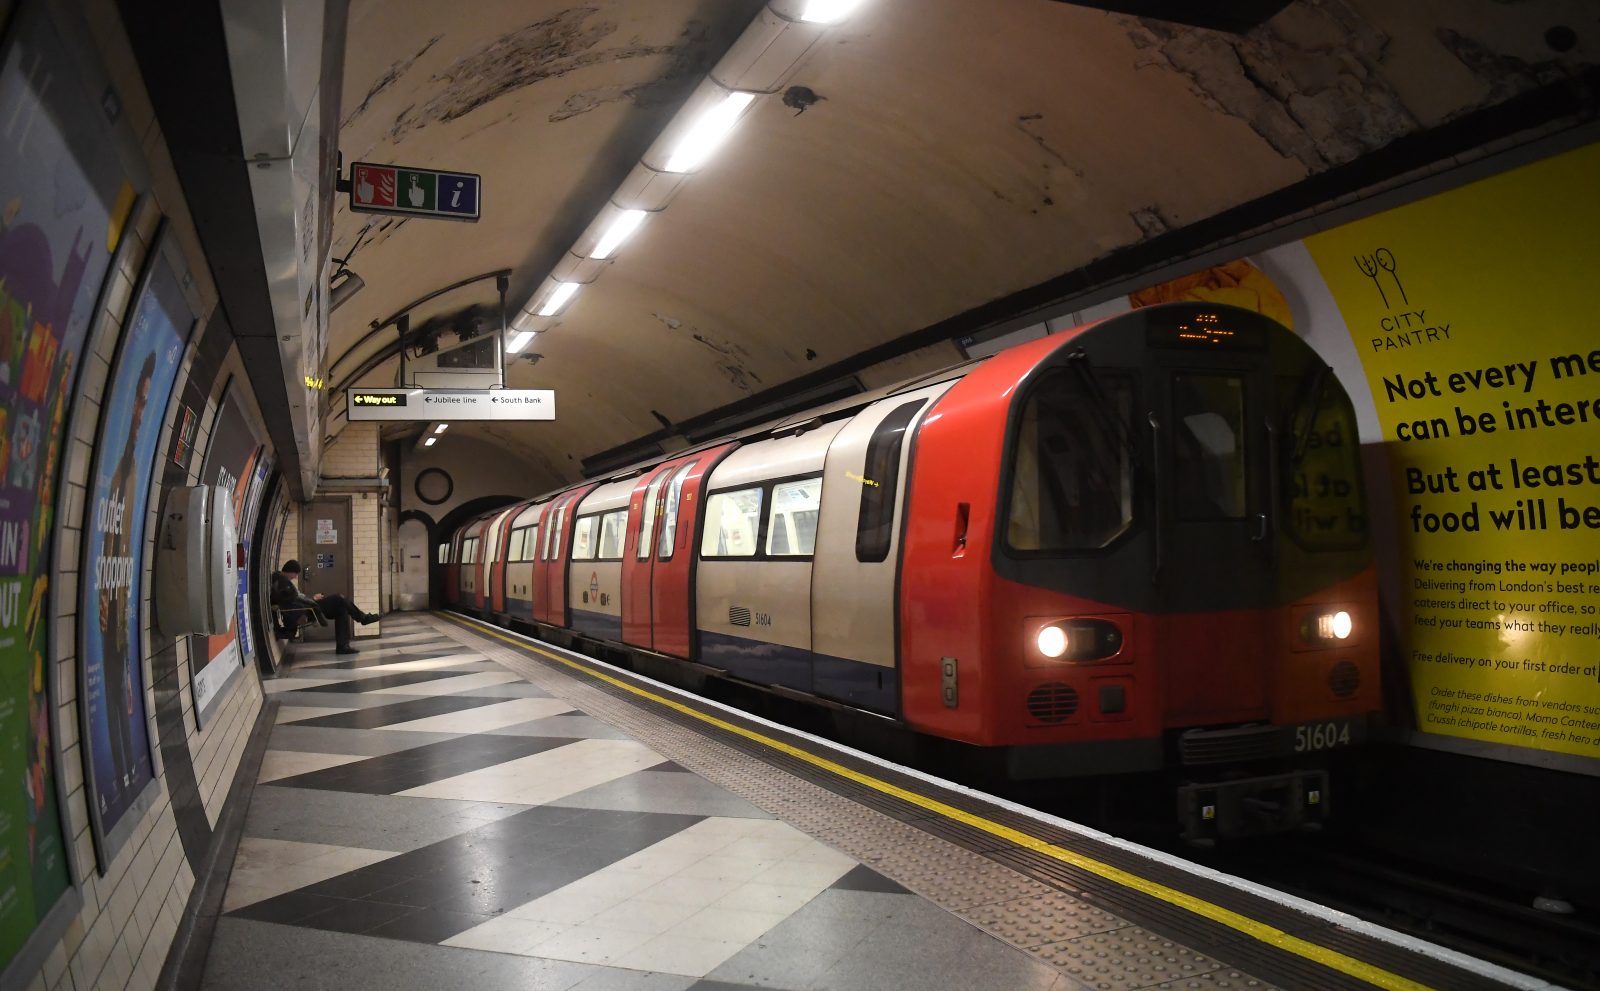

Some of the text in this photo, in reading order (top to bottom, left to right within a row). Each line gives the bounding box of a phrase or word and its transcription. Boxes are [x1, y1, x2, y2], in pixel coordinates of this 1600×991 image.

[1380, 310, 1426, 332] CITY
[1371, 324, 1451, 352] PANTRY
[1383, 371, 1442, 403] Not
[1448, 360, 1537, 394] every
[363, 396, 397, 405] Way out
[433, 396, 477, 404] Jubilee line
[500, 396, 542, 404] South Bank
[1396, 415, 1450, 442] can
[1454, 406, 1497, 436] be
[1406, 455, 1600, 495] But at least
[98, 488, 125, 535] outlet
[1410, 497, 1600, 533] food will be
[94, 541, 134, 601] shopping
[1413, 559, 1600, 575] We're changing the way peopl
[1414, 578, 1466, 593] Delivering
[1469, 579, 1496, 591] from
[1500, 580, 1552, 592] London's
[1557, 581, 1584, 594] best
[0, 581, 21, 629] UT
[1414, 598, 1596, 615] caterers direct to your office, so
[755, 612, 772, 626] 51604
[1414, 614, 1437, 627] feed
[1439, 619, 1463, 630] your
[1466, 617, 1500, 630] teams
[1504, 620, 1534, 632] what
[1538, 621, 1566, 636] they
[1412, 651, 1596, 677] Free delivery on your first order at
[1431, 686, 1455, 698] Order
[1457, 688, 1482, 701] these
[1484, 692, 1513, 705] dishes
[1516, 695, 1539, 708] from
[1541, 699, 1581, 713] vendors
[1427, 712, 1456, 725] Crussh
[1457, 717, 1498, 732] (chipotle
[1541, 727, 1566, 741] fresh
[1460, 703, 1484, 716] pizza
[1525, 712, 1558, 725] Momo
[1294, 721, 1350, 752] 51604
